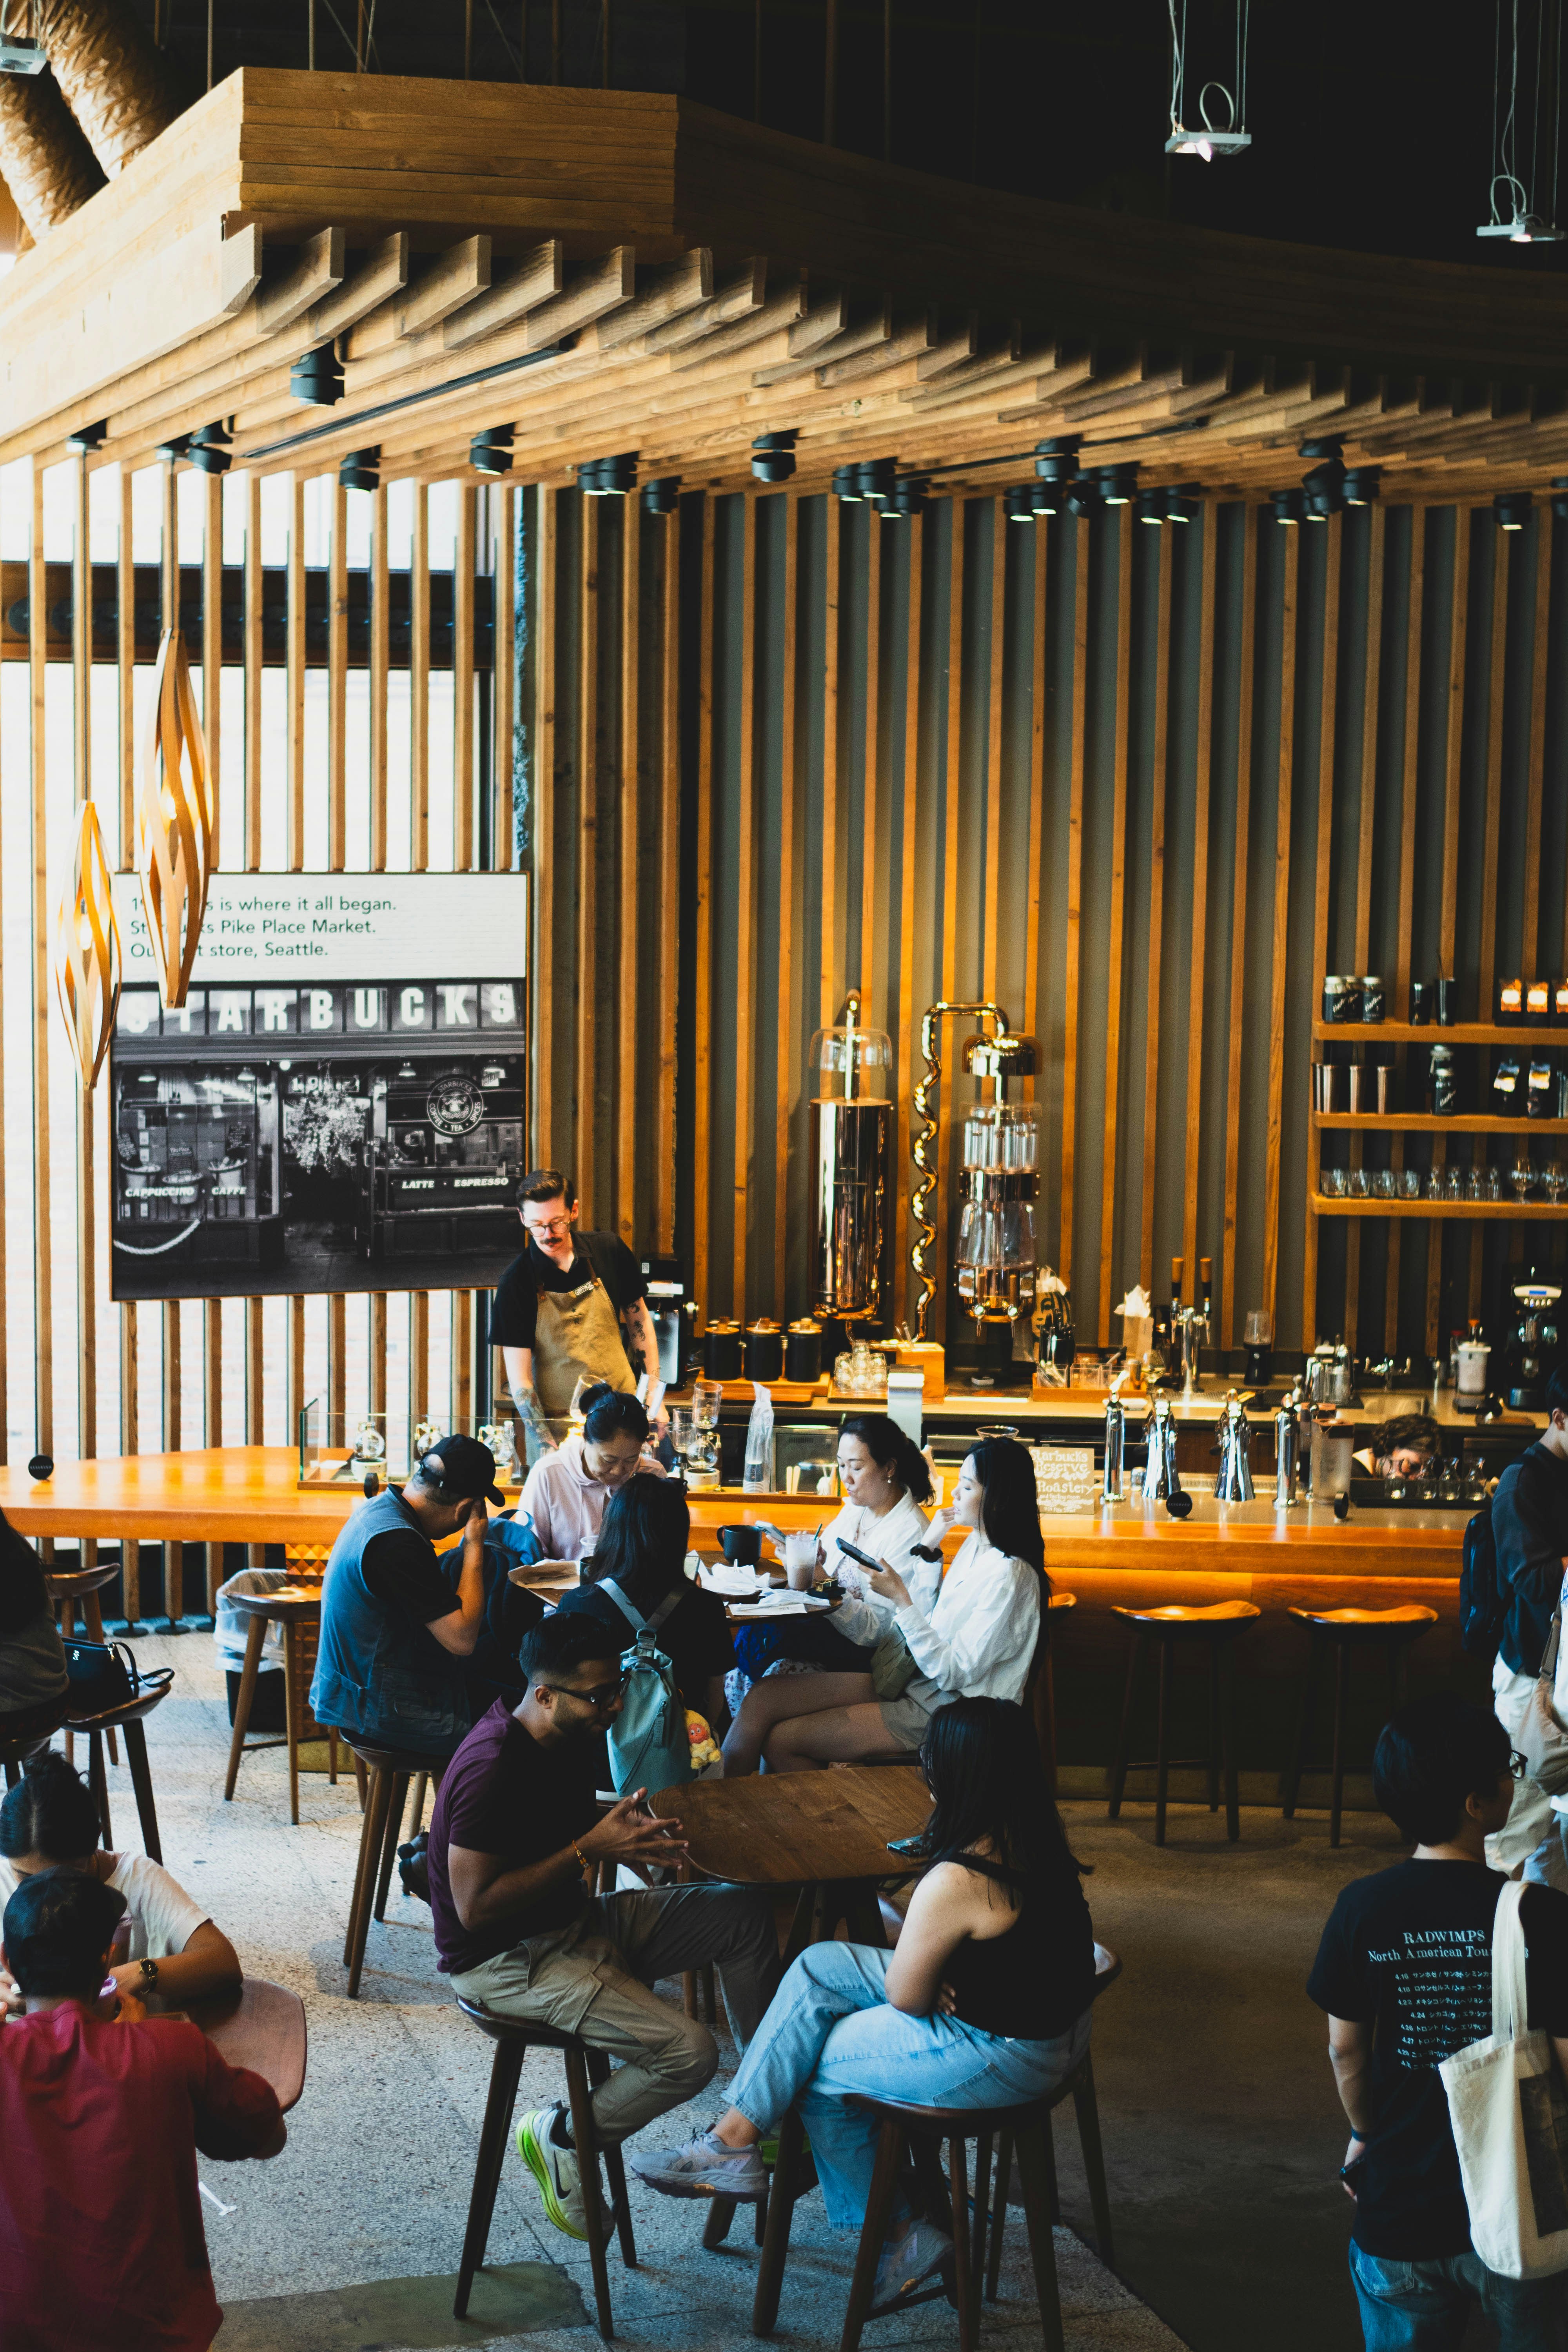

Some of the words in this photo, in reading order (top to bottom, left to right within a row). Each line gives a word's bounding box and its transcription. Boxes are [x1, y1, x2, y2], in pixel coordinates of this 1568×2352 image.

[220, 897, 232, 911] is
[239, 897, 291, 911] where
[298, 897, 309, 911] it
[315, 896, 333, 911] all
[339, 896, 396, 914] began.
[221, 919, 255, 934] Pike
[263, 919, 305, 934] Place
[312, 918, 376, 933] Market.
[210, 944, 257, 958] store,
[265, 941, 328, 956] Seattle.
[437, 1080, 473, 1093] STARBUCKS
[429, 1103, 443, 1126] COFFEE
[470, 1101, 481, 1122] SPICES
[401, 1180, 435, 1189] LATTE
[454, 1177, 509, 1187] ESPRESSO
[125, 1186, 195, 1198] CAPPUCCINO
[211, 1186, 247, 1195] CAFFE
[1030, 1449, 1088, 1462] Starbucks
[1034, 1460, 1088, 1472] Reserve
[1036, 1481, 1094, 1495] Roastery
[1403, 1929, 1485, 1944] RADWIMPS
[1367, 1949, 1401, 1963] North
[1405, 1945, 1463, 1960] American
[1402, 2036, 1414, 2045] 4.27
